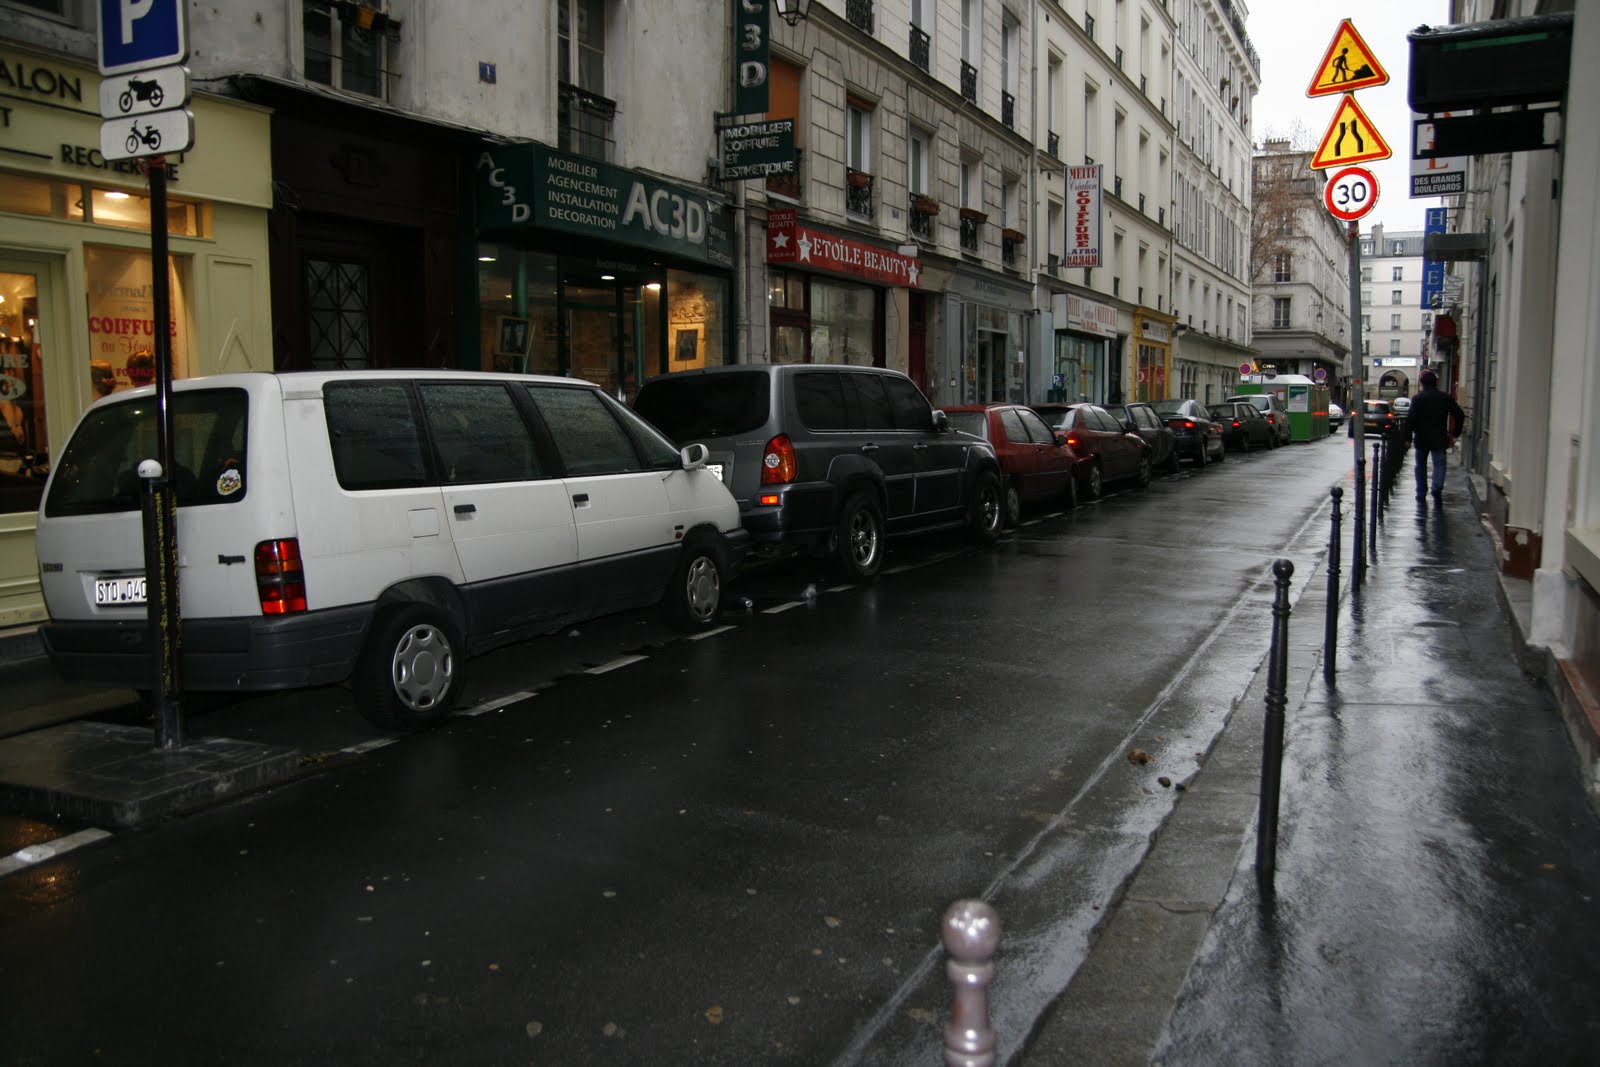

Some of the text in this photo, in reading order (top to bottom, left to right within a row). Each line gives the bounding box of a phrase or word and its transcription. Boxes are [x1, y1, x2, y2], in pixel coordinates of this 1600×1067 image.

[120, 0, 156, 45] P
[547, 156, 598, 179] MOBILIER
[1414, 174, 1461, 186] DES GRANDS
[546, 174, 619, 199] AGENCEMENT
[1336, 181, 1367, 206] 30
[1414, 183, 1461, 194] BOULEVARDS
[547, 190, 619, 215] INSTALLATION
[621, 181, 706, 245] AC3D
[549, 206, 616, 230] DECORATION
[1076, 190, 1091, 248] COIFFURE
[864, 250, 907, 277] BEAUTY
[1425, 211, 1445, 305] HEL
[89, 316, 177, 338] COIFFUE
